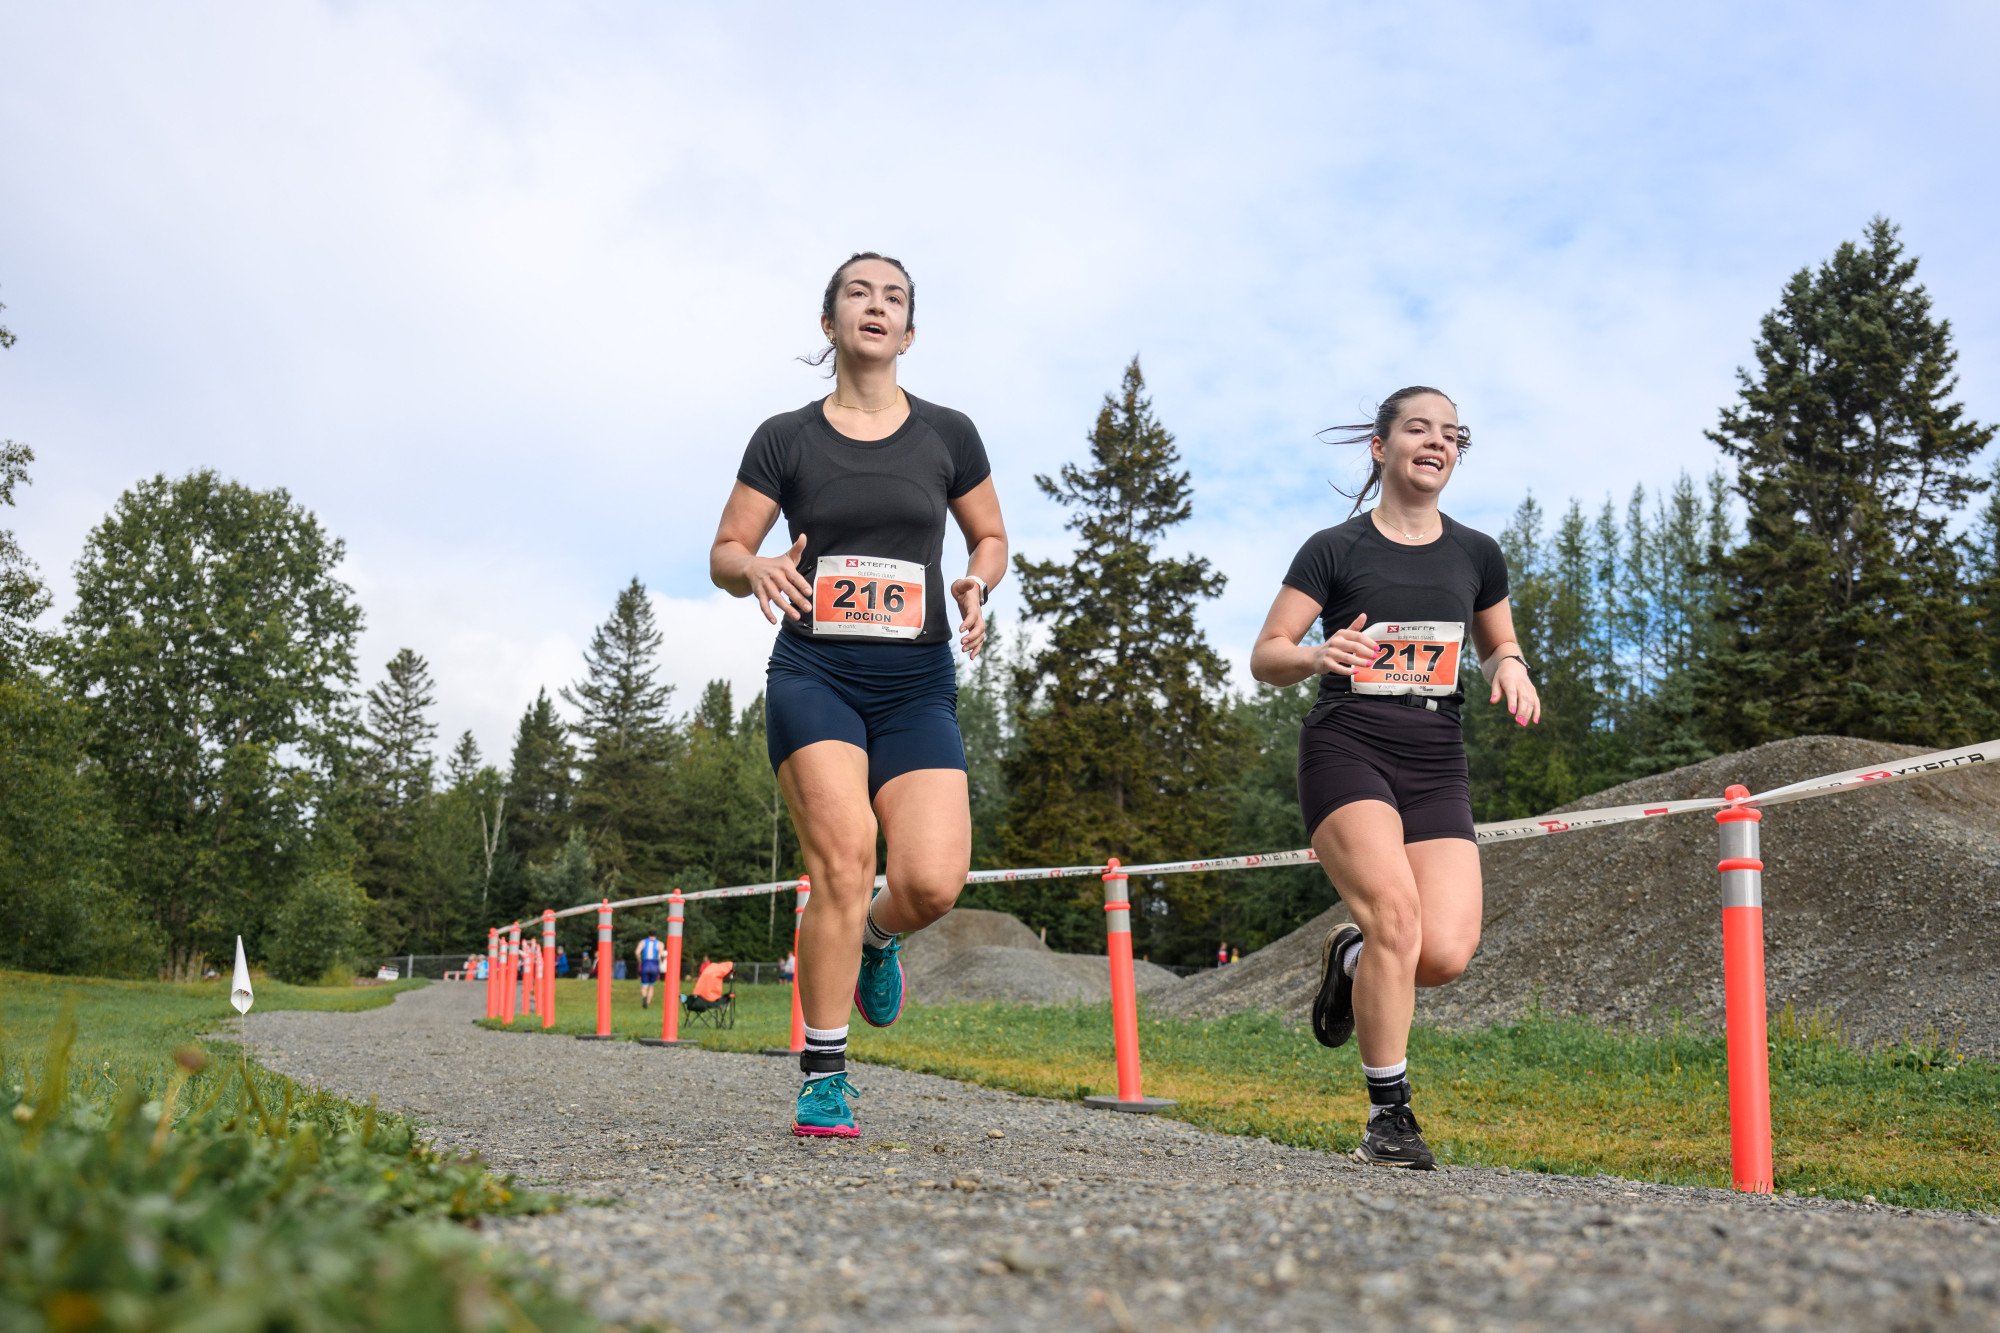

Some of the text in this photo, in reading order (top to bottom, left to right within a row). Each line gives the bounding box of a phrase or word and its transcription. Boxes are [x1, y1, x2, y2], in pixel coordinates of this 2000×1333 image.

[860, 561, 897, 569] XTERRA
[832, 580, 905, 613] 216
[845, 611, 891, 623] POCION
[1372, 643, 1445, 672] 217
[1385, 673, 1430, 683] POCION
